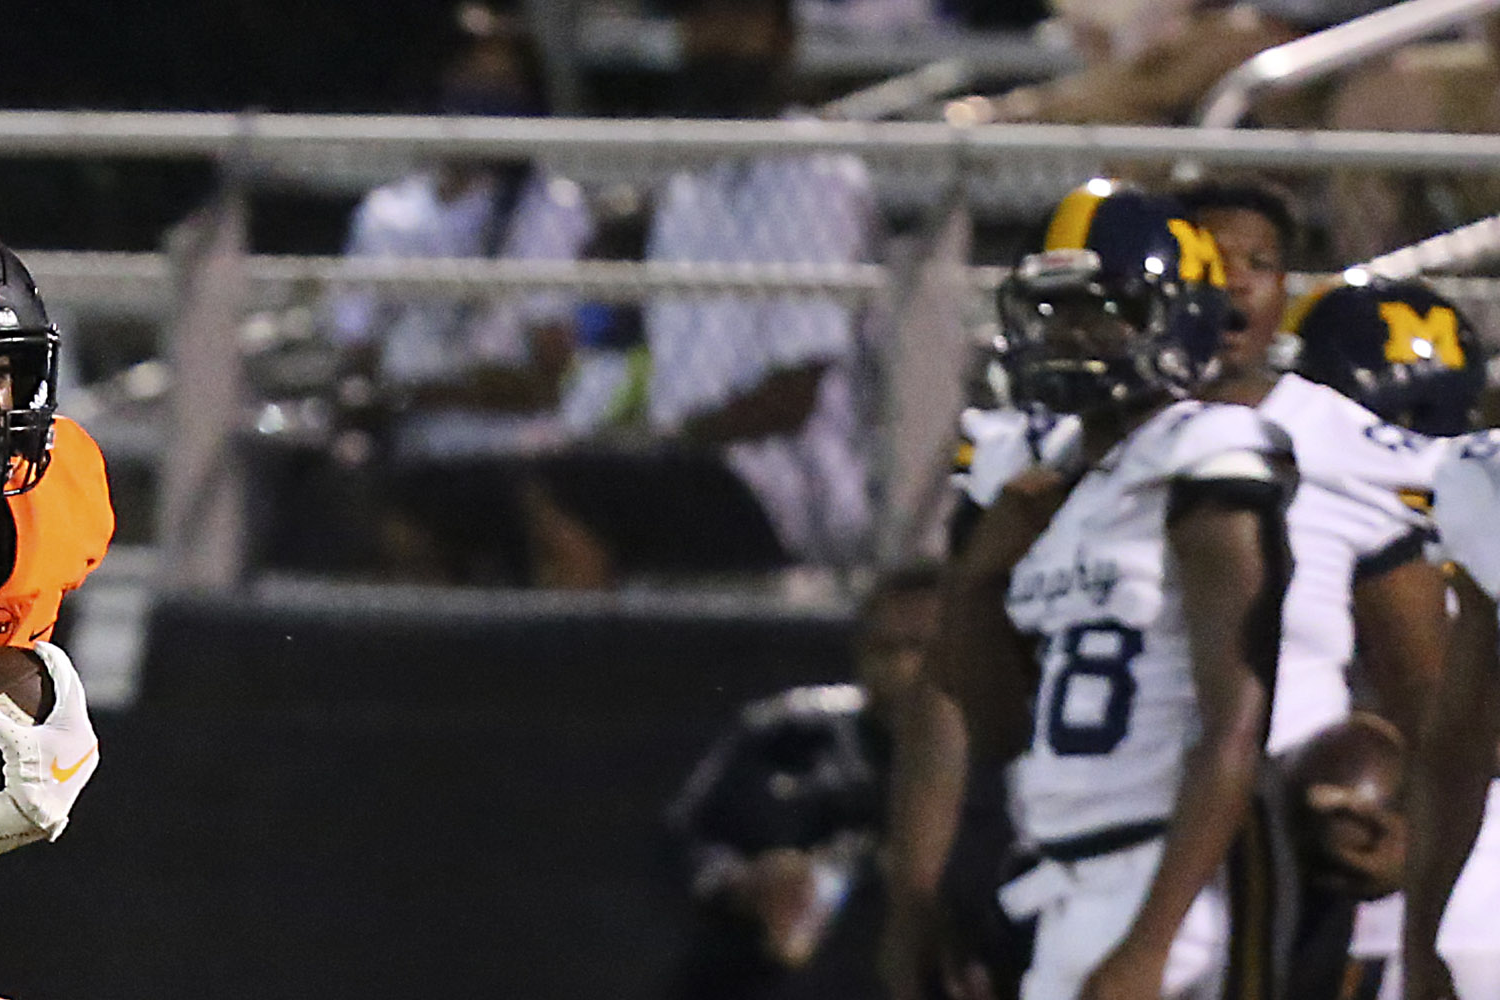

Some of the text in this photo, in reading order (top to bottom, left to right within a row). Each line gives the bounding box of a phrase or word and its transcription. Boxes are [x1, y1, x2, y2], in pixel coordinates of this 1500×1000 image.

[1167, 218, 1228, 289] M
[1380, 301, 1466, 370] M
[1034, 617, 1145, 756] 8
